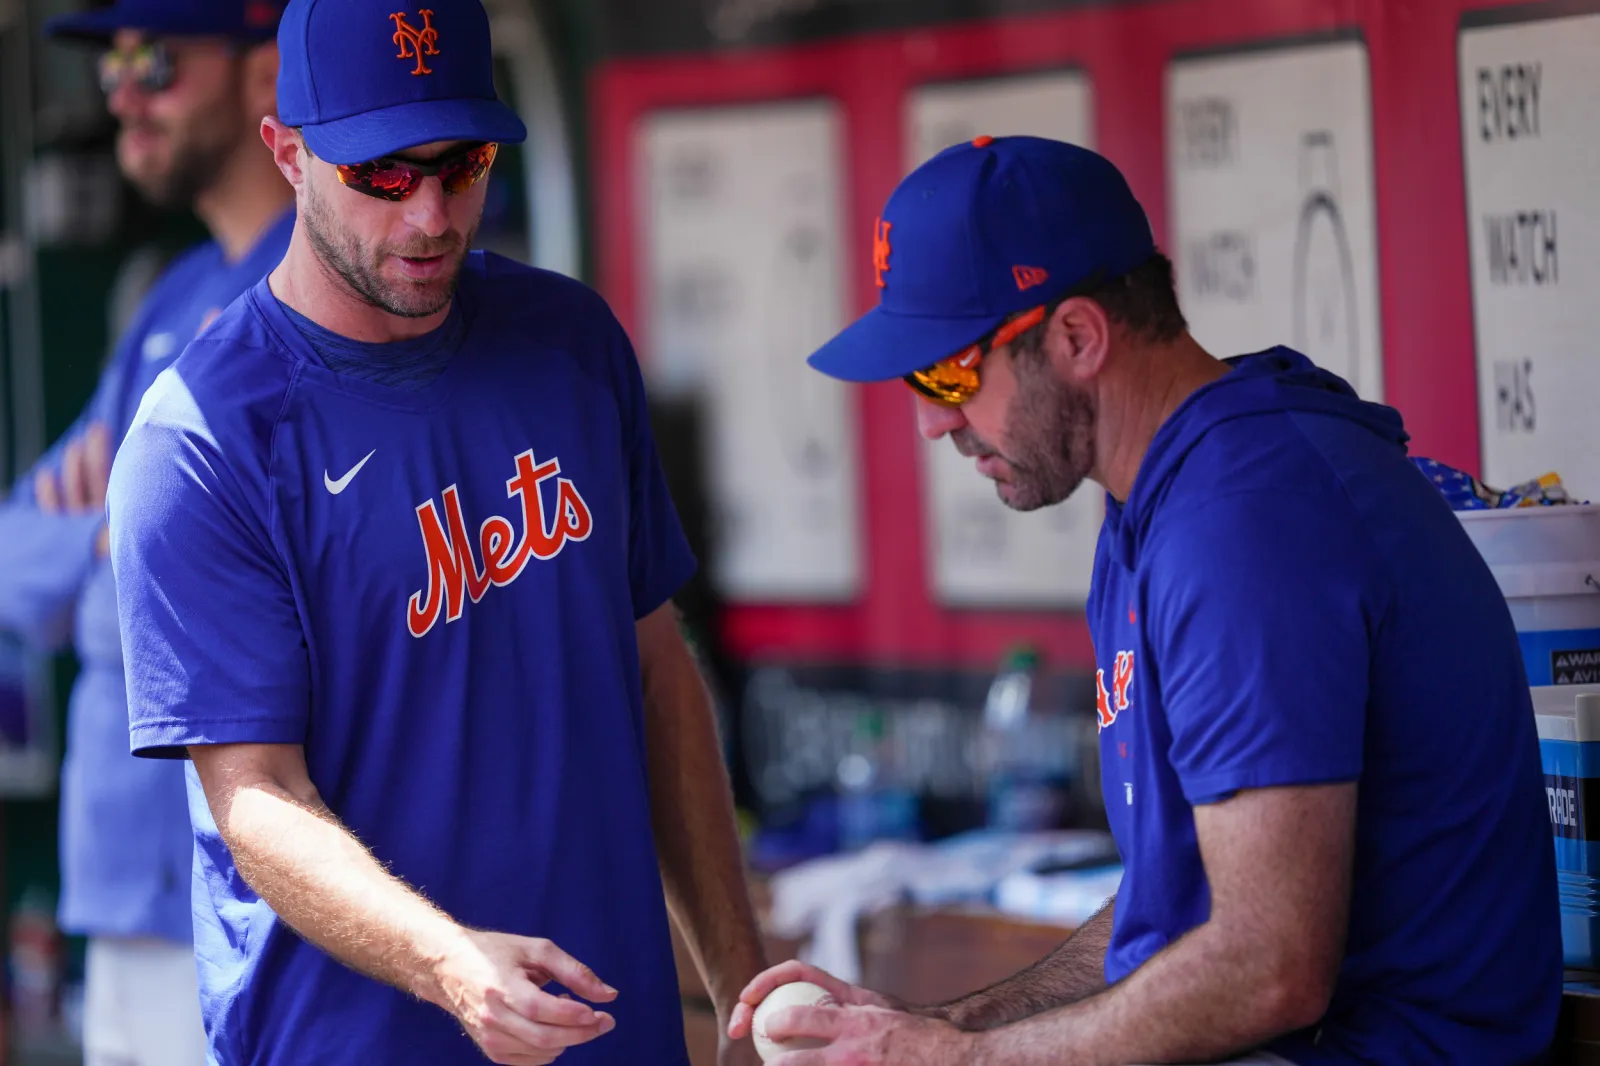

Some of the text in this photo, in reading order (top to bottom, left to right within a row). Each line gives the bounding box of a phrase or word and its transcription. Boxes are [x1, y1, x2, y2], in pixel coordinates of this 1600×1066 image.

[1476, 64, 1541, 142] EVERY
[1483, 211, 1558, 285] WATCH
[1495, 358, 1536, 434] HAS
[407, 448, 593, 638] Mets
[1572, 669, 1600, 684] AVI
[1545, 786, 1577, 827] RADE
